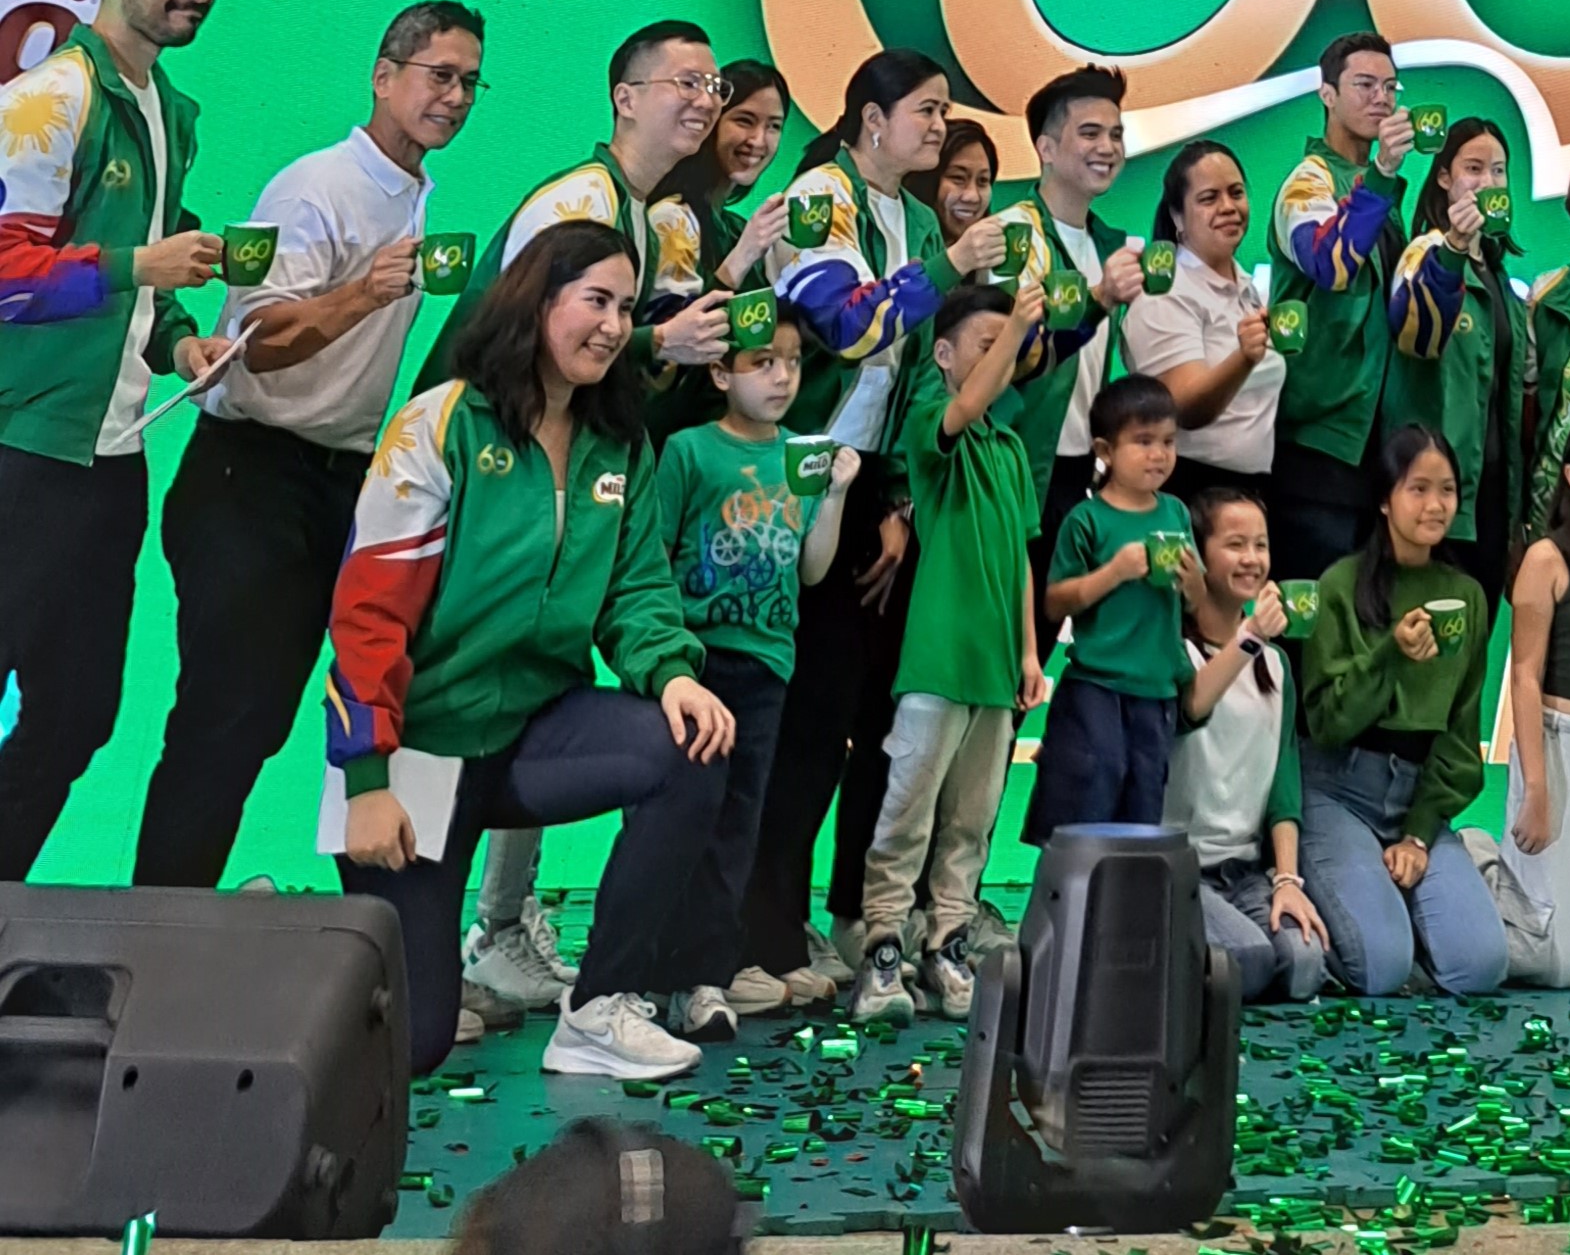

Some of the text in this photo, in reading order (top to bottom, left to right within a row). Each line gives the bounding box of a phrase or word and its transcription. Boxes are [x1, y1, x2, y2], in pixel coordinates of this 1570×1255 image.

[1420, 110, 1442, 128] 60
[1488, 194, 1510, 211] 60
[806, 205, 830, 225] 60
[236, 238, 271, 262] 60
[1153, 246, 1174, 267] 60
[742, 301, 769, 324] 60
[1277, 309, 1300, 329] 60
[477, 444, 514, 476] 60
[804, 453, 829, 470] MILO
[600, 480, 624, 496] MIL
[1443, 615, 1464, 636] 60
